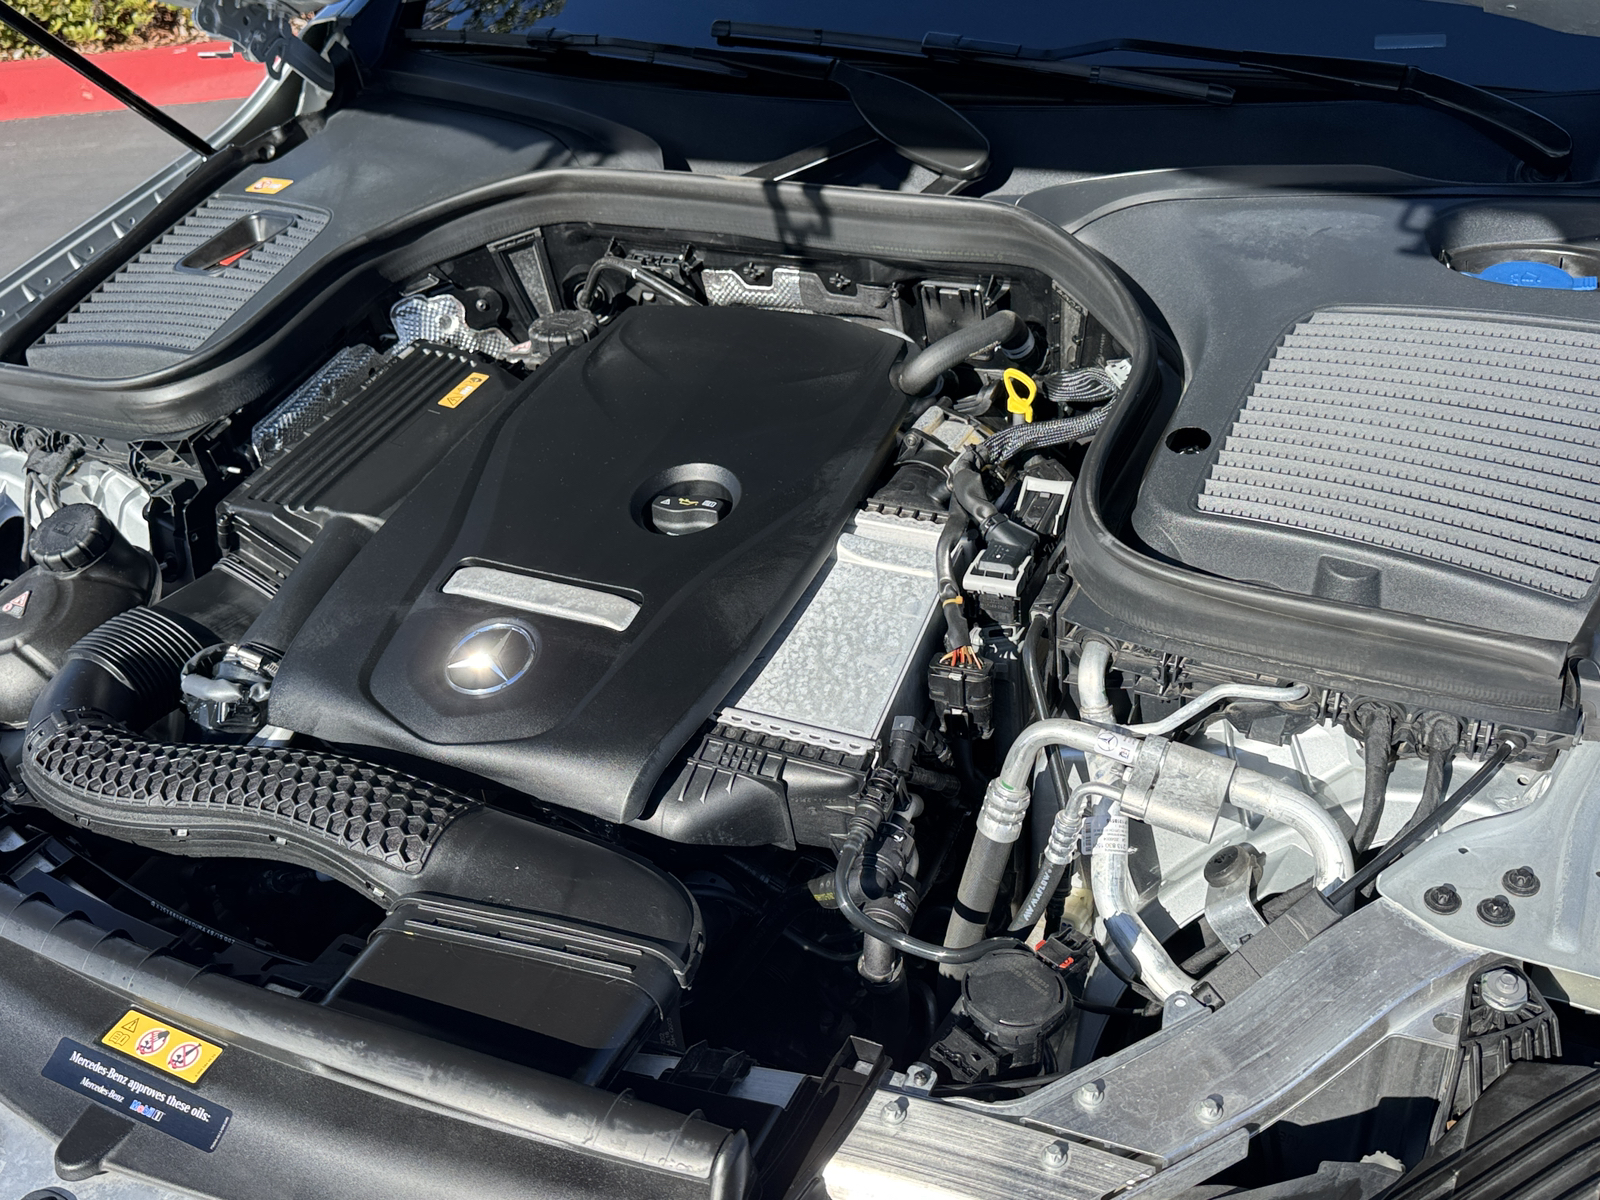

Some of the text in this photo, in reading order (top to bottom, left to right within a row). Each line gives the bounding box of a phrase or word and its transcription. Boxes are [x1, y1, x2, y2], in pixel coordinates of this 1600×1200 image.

[69, 1050, 212, 1122] Mercedes-Benz approves these oils:
[80, 1076, 125, 1103] Mercedes-Benz
